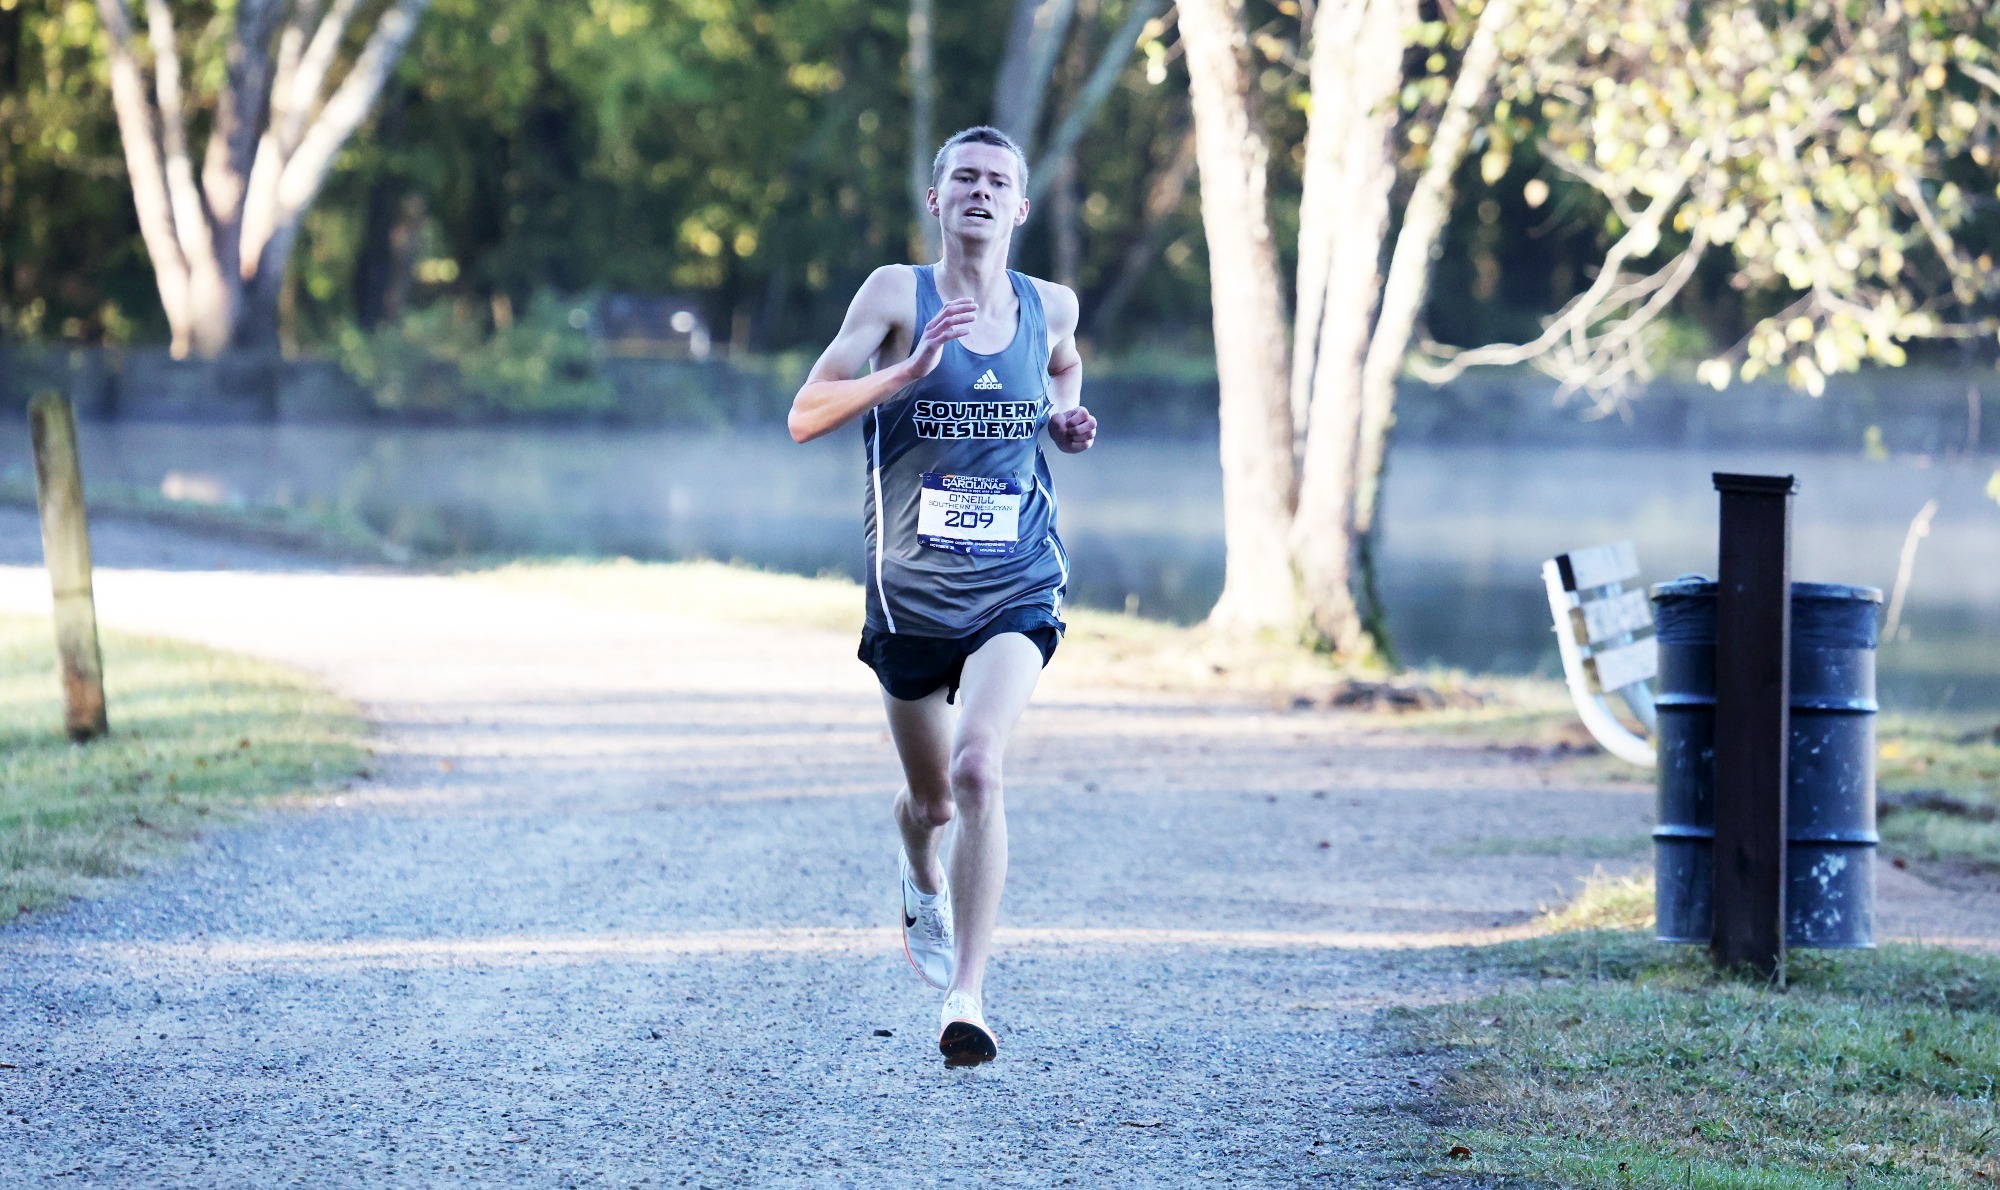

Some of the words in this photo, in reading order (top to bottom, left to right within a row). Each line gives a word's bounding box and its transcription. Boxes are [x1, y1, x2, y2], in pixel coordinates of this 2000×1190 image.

[973, 382, 1003, 390] adidas
[913, 400, 1039, 420] SOUTHERN
[913, 418, 1036, 440] WESLEYAN
[942, 476, 1008, 491] CAROLINAS
[956, 475, 999, 483] CONFERENCE
[928, 500, 971, 510] SOUTHERN
[949, 493, 995, 505] O'NEILL
[944, 510, 994, 529] 209
